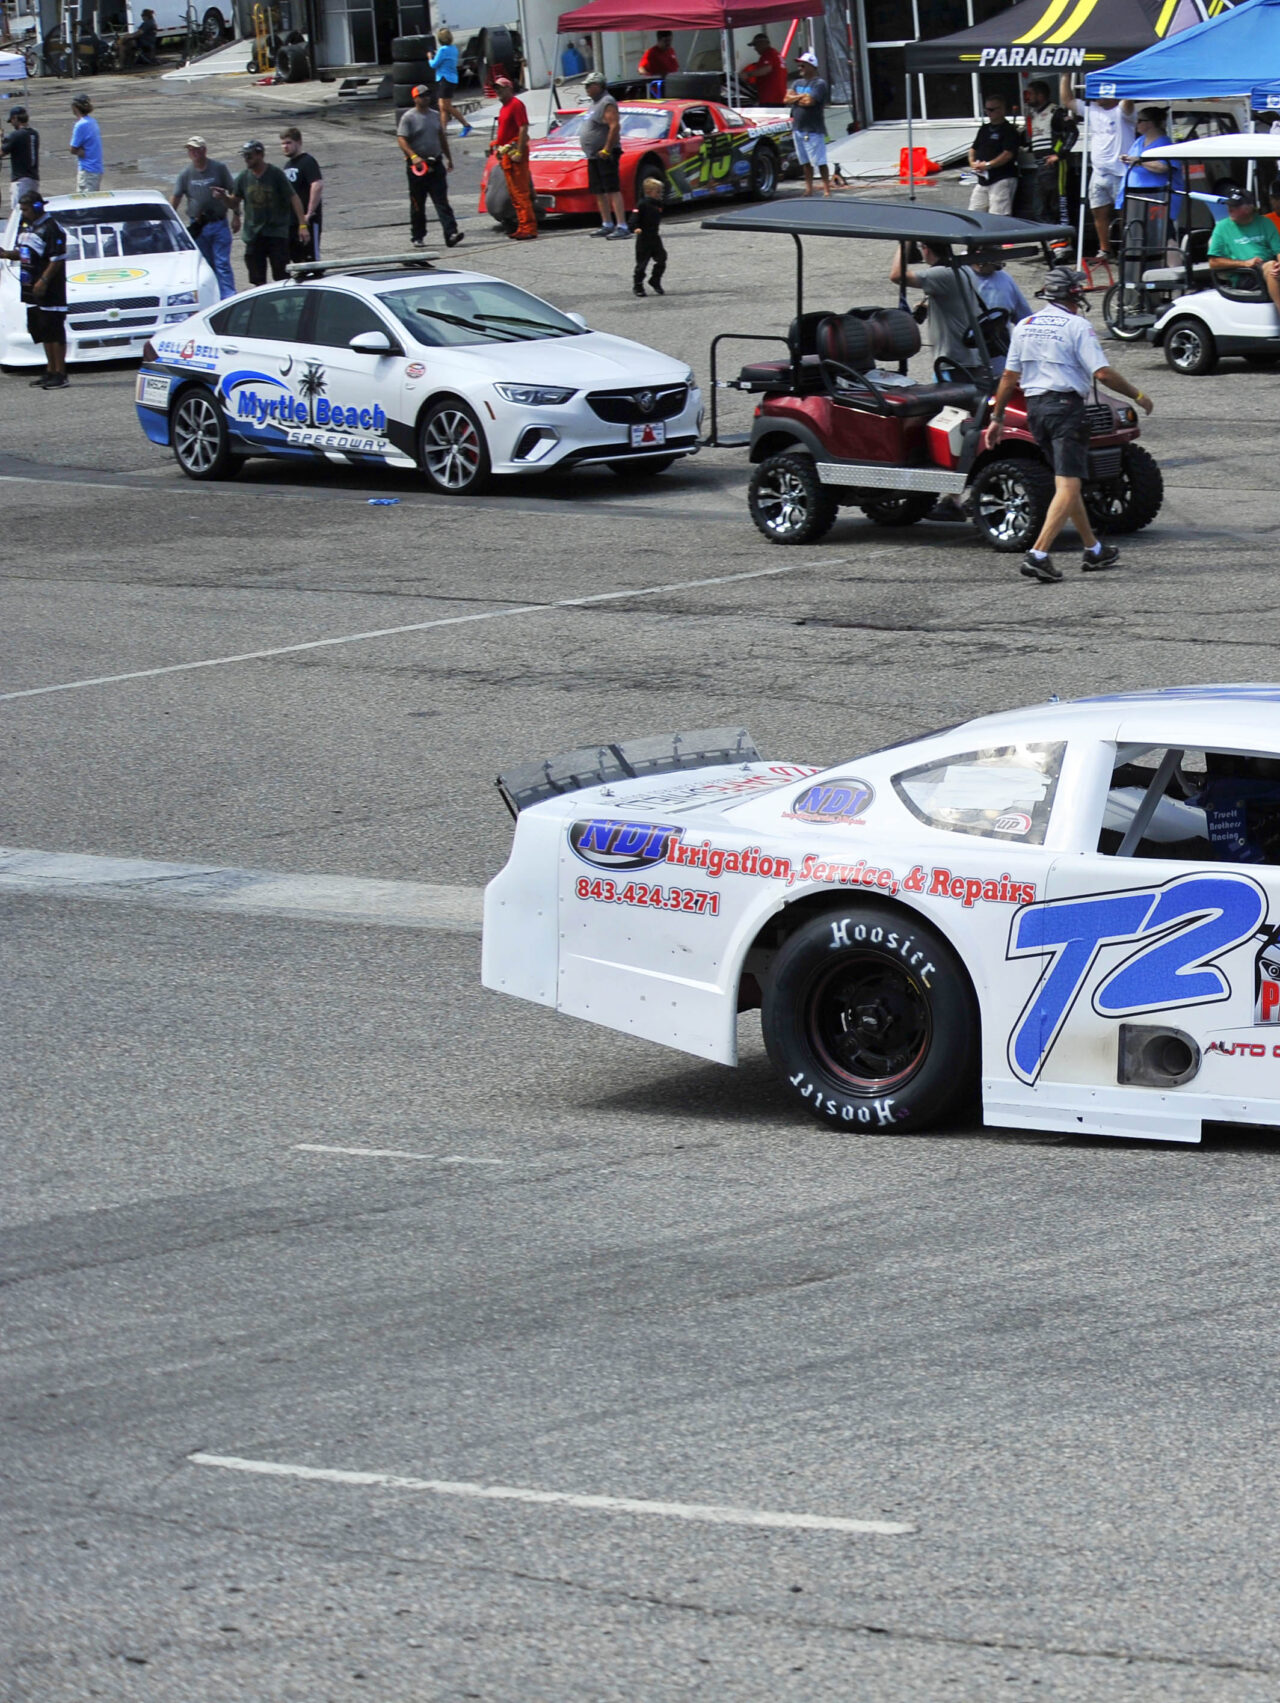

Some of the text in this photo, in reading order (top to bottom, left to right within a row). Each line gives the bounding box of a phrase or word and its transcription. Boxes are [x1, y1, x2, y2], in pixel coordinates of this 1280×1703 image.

[979, 48, 1085, 67] PARAGON
[158, 341, 220, 359] BELL BELL
[237, 390, 386, 430] Myrtle Beach
[289, 432, 388, 451] SPEEDWAY
[798, 786, 868, 815] NDI
[1211, 832, 1239, 841] Racing
[578, 818, 1036, 907] NDI Irrigation, Service, & Repairs
[575, 878, 720, 915] 843.424.3271
[829, 918, 937, 978] Hoosier
[1006, 871, 1268, 1087] T2
[1203, 1040, 1266, 1058] AUTO
[789, 1072, 897, 1127] Hoosier
